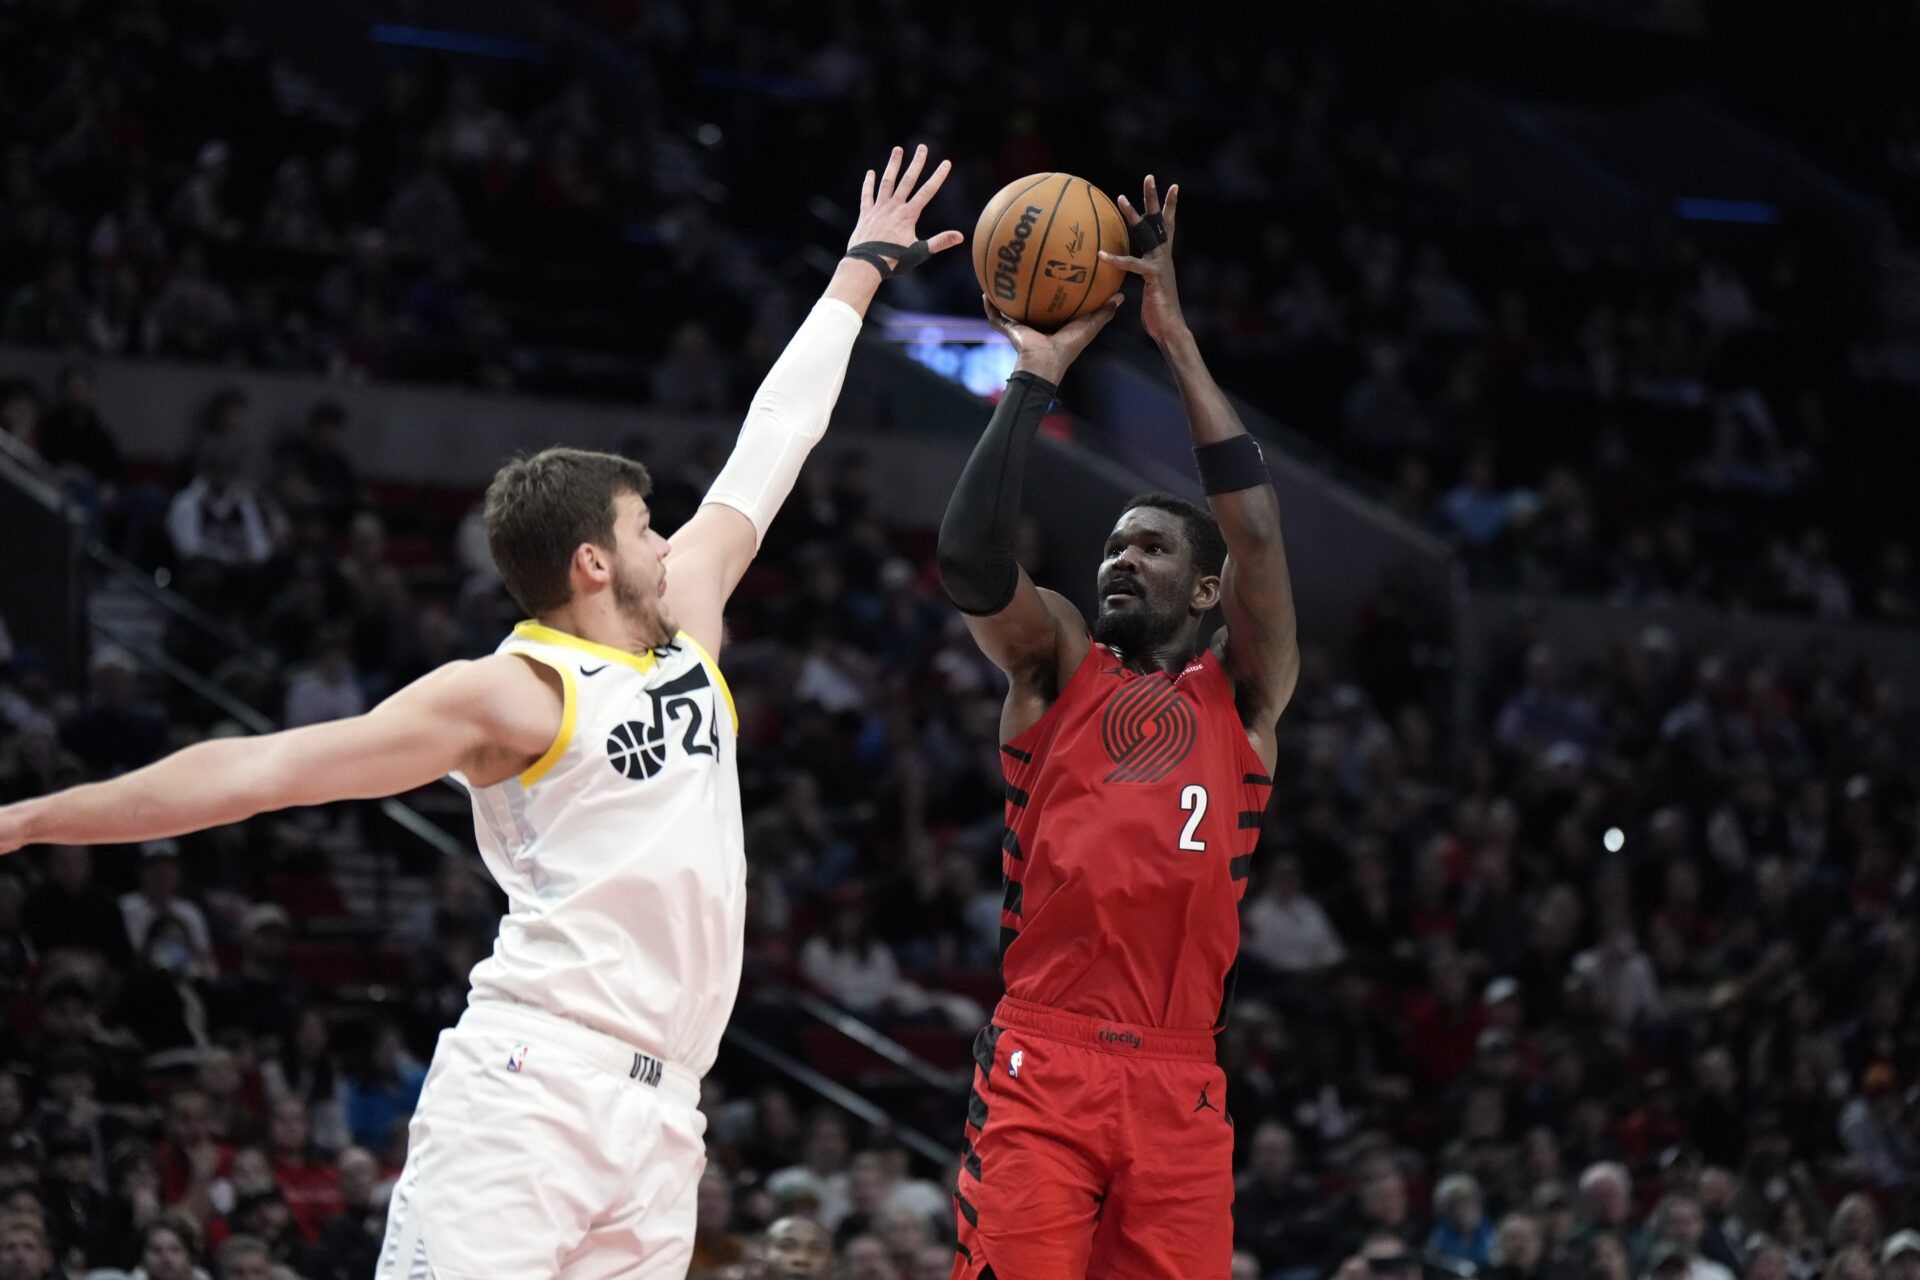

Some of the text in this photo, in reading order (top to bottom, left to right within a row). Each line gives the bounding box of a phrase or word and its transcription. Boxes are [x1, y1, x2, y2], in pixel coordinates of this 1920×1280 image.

[994, 205, 1042, 300] Wilson
[1178, 784, 1208, 851] 2
[1098, 1026, 1142, 1049] ripcity
[629, 1052, 664, 1088] UTAH
